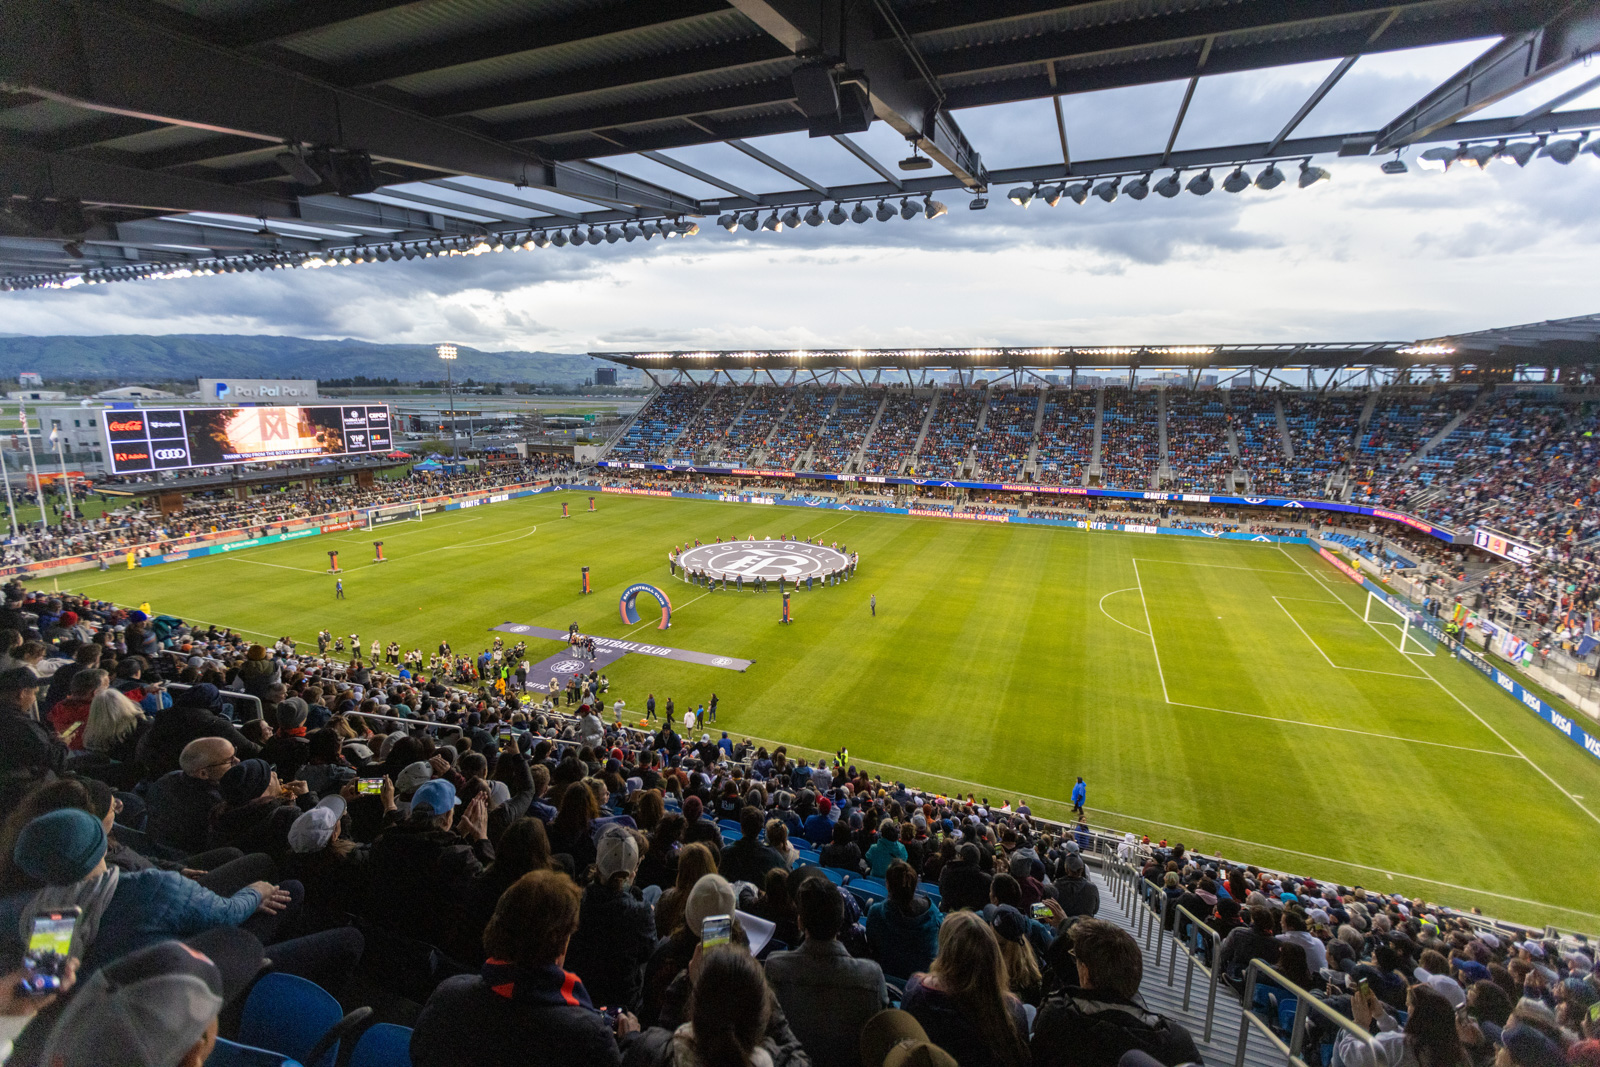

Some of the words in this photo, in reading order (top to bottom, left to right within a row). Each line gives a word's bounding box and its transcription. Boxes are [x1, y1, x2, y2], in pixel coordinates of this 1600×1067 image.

[235, 385, 279, 398] PayPal
[281, 385, 308, 397] Park
[109, 420, 143, 432] Coca-Cola
[908, 509, 951, 518] INAUGURAL
[977, 514, 1009, 522] OPENER
[1098, 522, 1106, 530] FC
[654, 592, 665, 605] CLUB
[638, 646, 672, 655] CLUB
[1497, 672, 1513, 692] VISA
[1522, 689, 1540, 712] VISA
[1551, 710, 1571, 735] VISA
